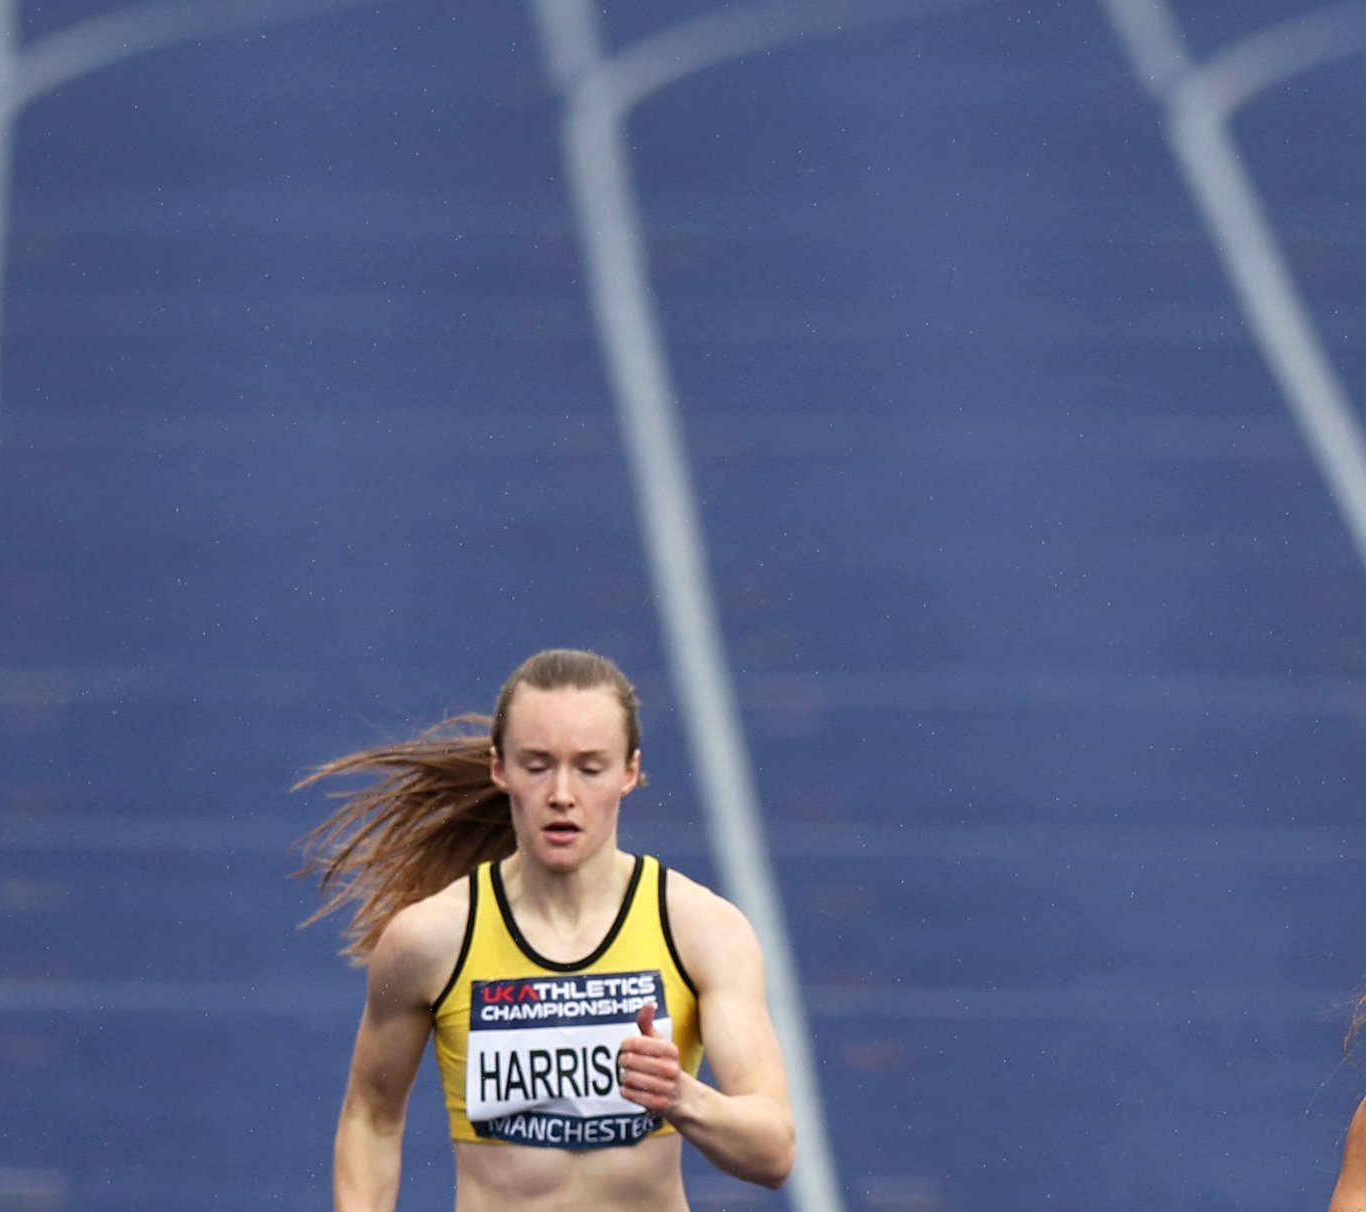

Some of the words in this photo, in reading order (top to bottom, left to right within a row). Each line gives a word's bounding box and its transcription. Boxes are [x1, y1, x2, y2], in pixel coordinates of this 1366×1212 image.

[482, 986, 515, 1004] UK
[518, 976, 656, 1002] ATHLETICS
[480, 1045, 622, 1102] HARRIS
[487, 1112, 655, 1143] MANCHESTER
